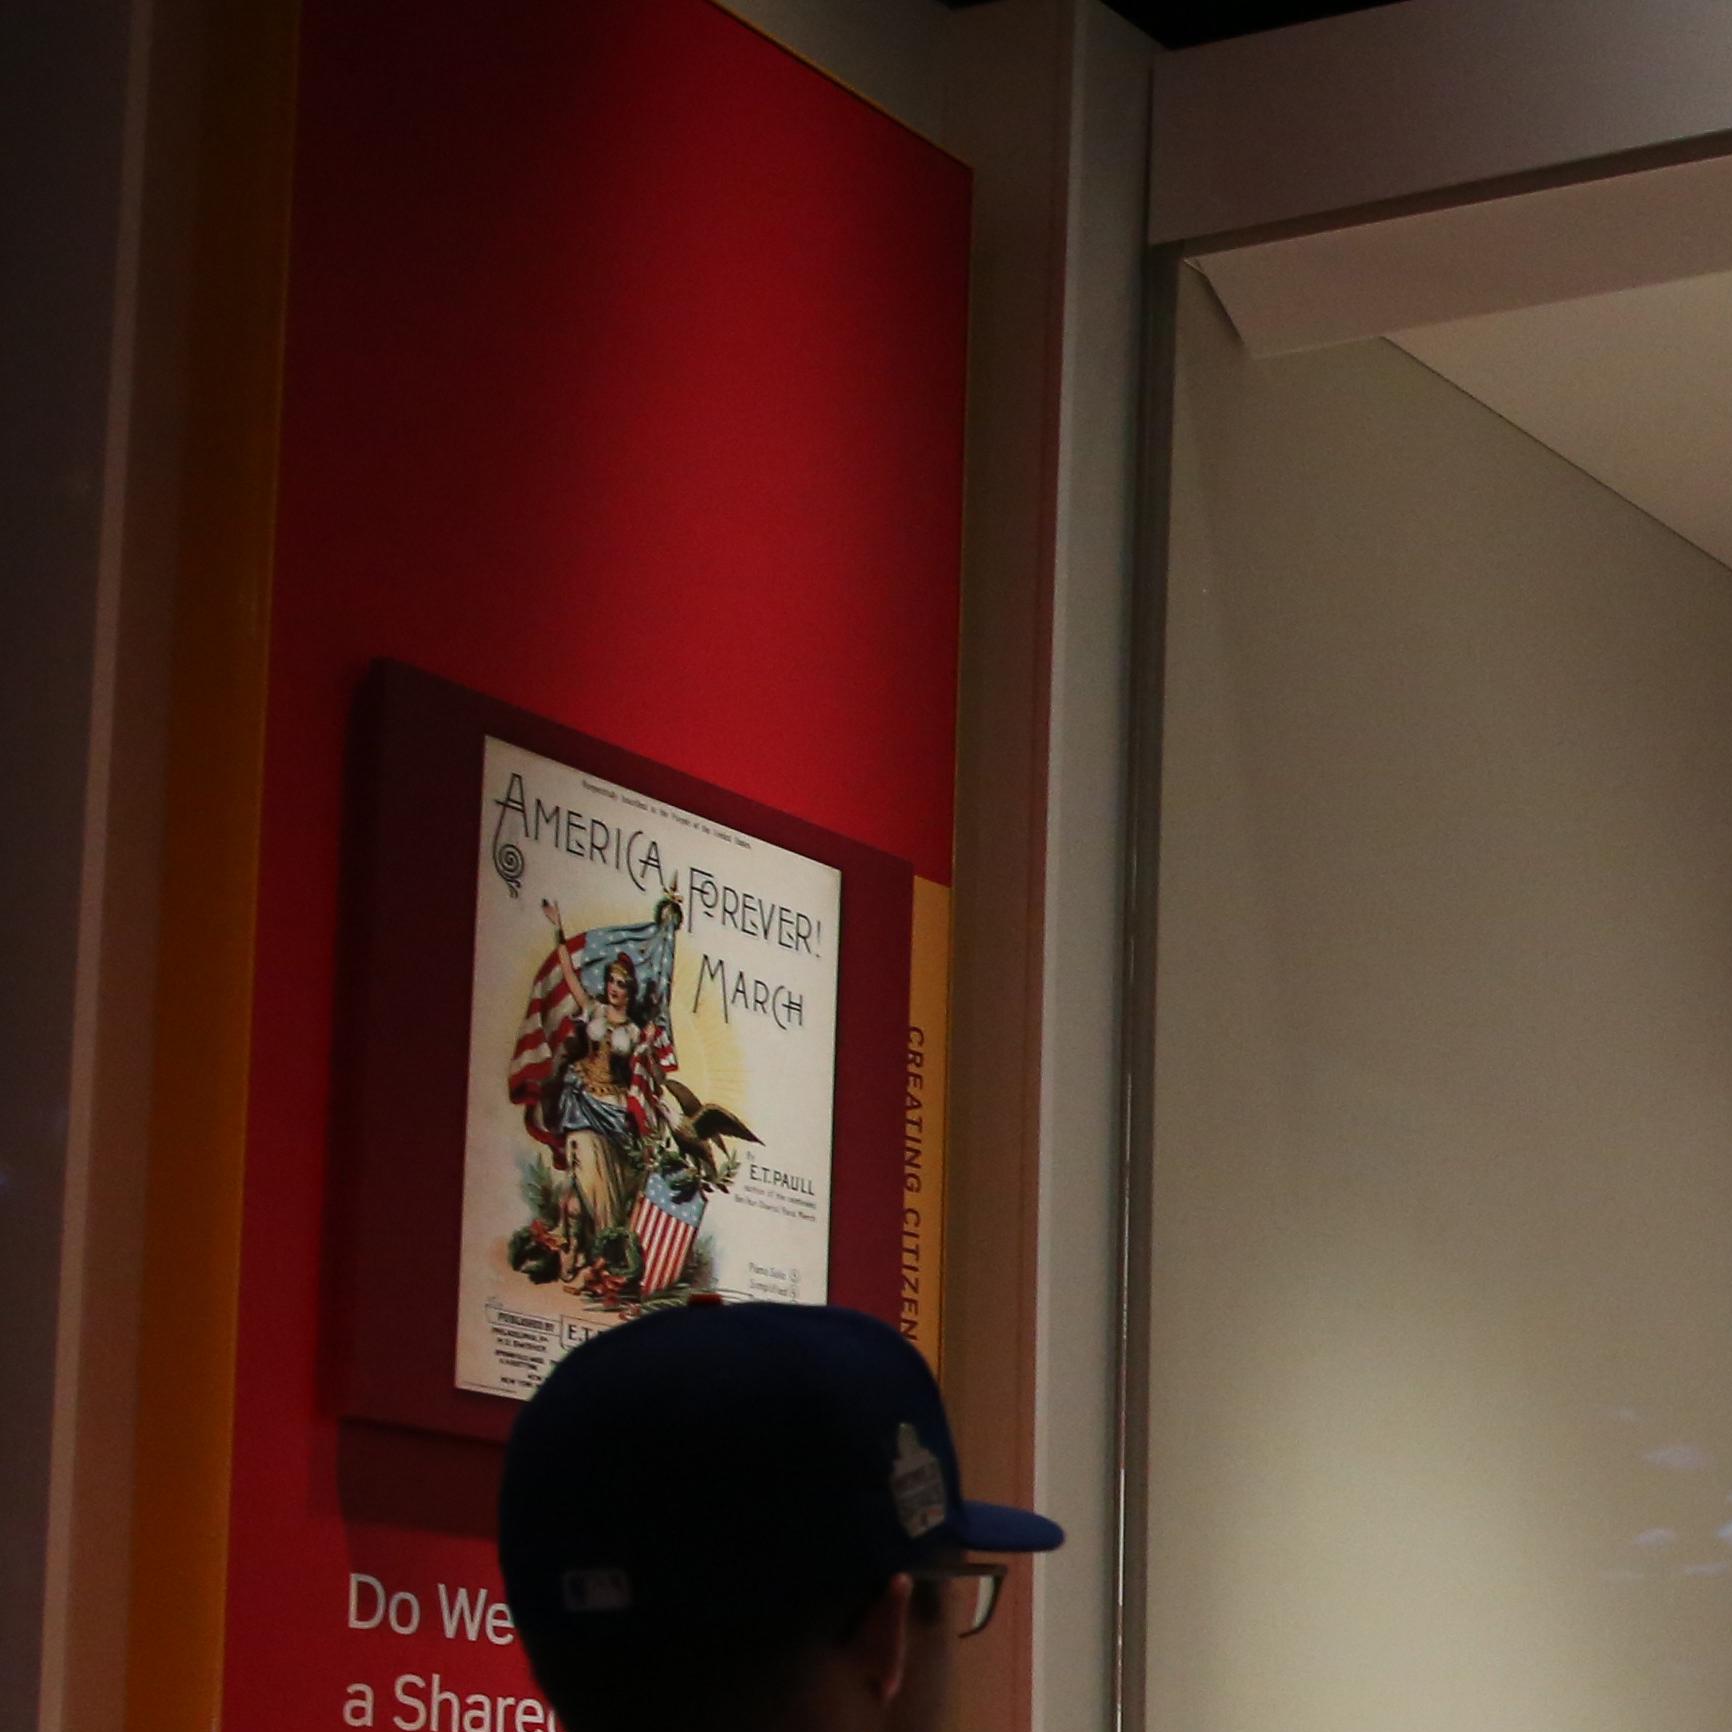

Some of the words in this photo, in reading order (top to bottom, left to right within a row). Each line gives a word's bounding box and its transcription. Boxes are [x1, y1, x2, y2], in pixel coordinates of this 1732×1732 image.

[491, 772, 664, 898] AMERICA
[686, 866, 822, 959] FOREVER!
[693, 954, 804, 1030] MARCH
[904, 1026, 925, 1193] CREATING
[899, 1208, 921, 1342] CITIZEN
[347, 1573, 420, 1637] Do
[437, 1583, 515, 1644] We
[344, 1680, 373, 1728] a
